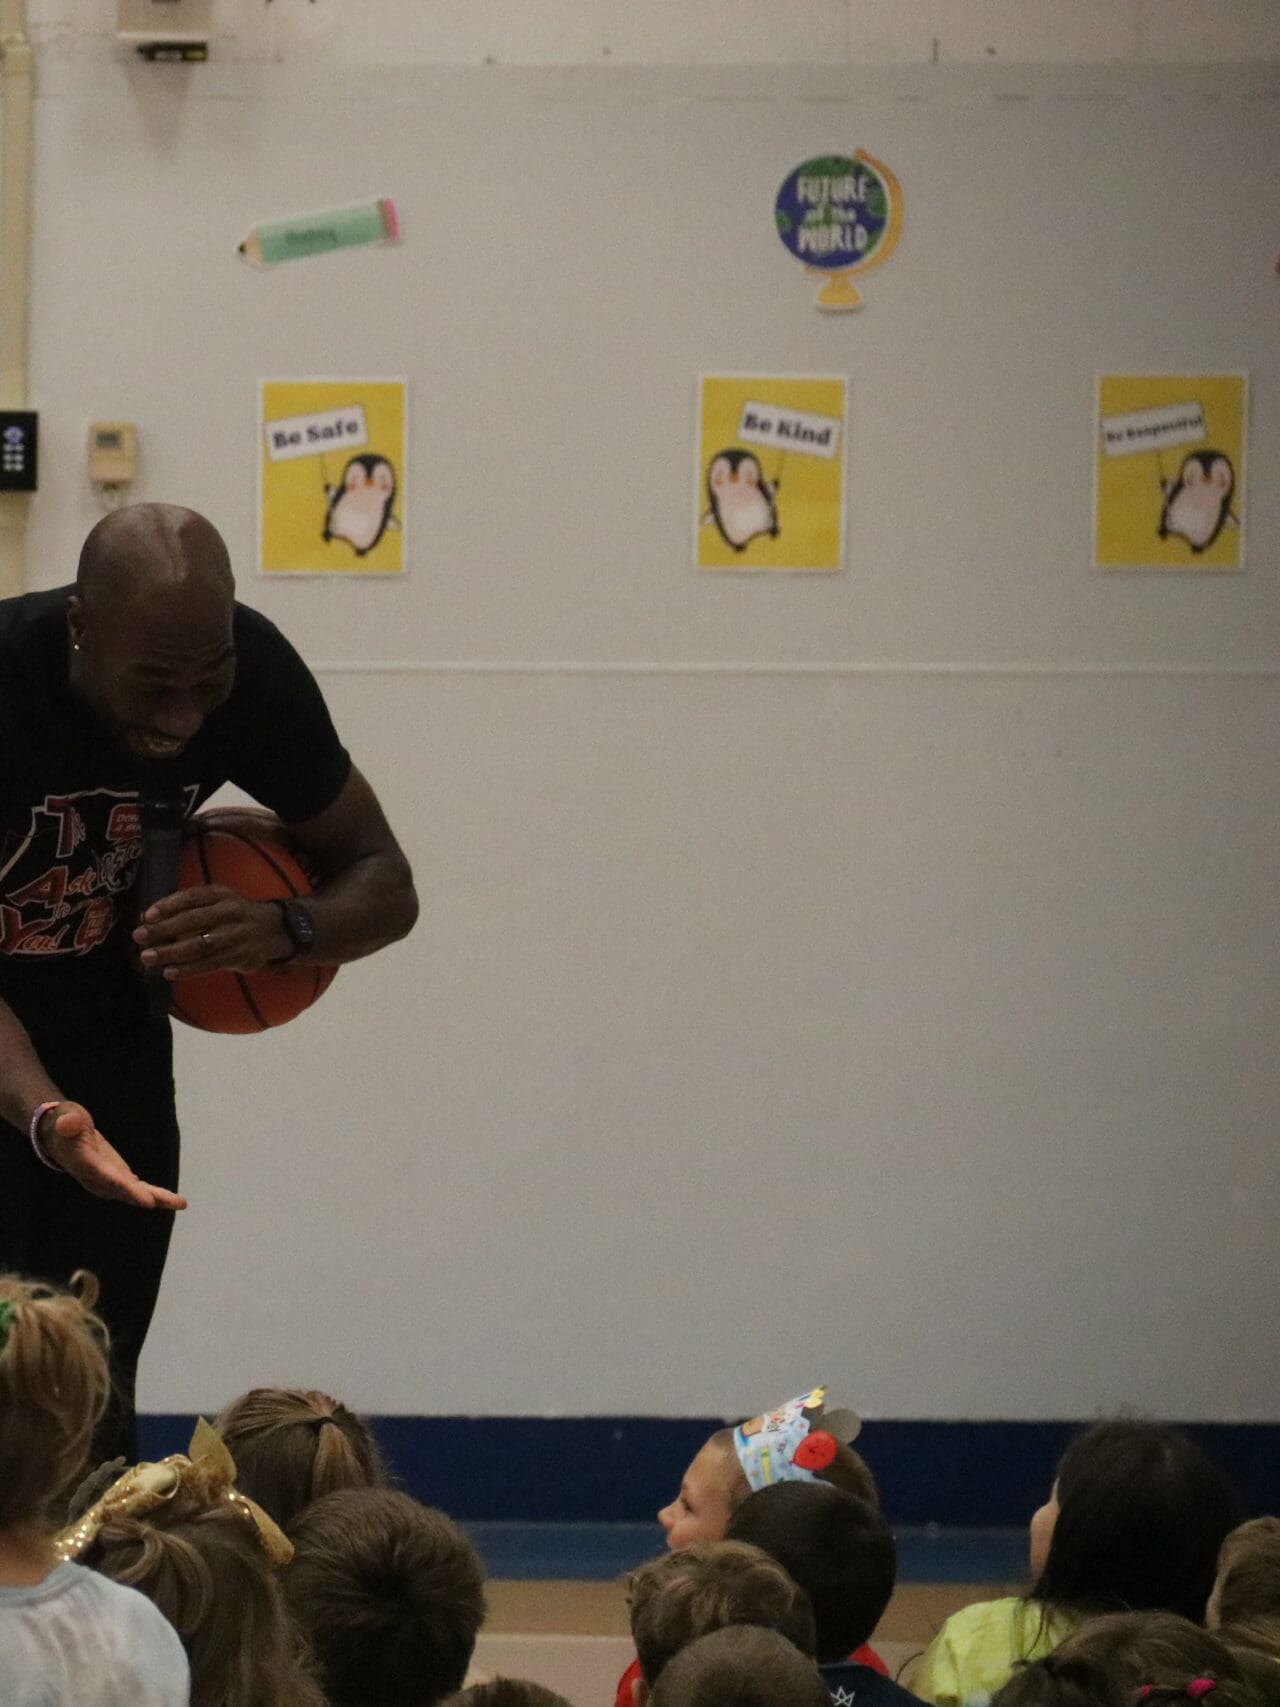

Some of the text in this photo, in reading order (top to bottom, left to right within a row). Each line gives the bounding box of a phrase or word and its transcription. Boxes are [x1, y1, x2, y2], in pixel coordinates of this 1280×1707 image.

[273, 419, 359, 448] Be Safe
[743, 413, 832, 446] Be Kind
